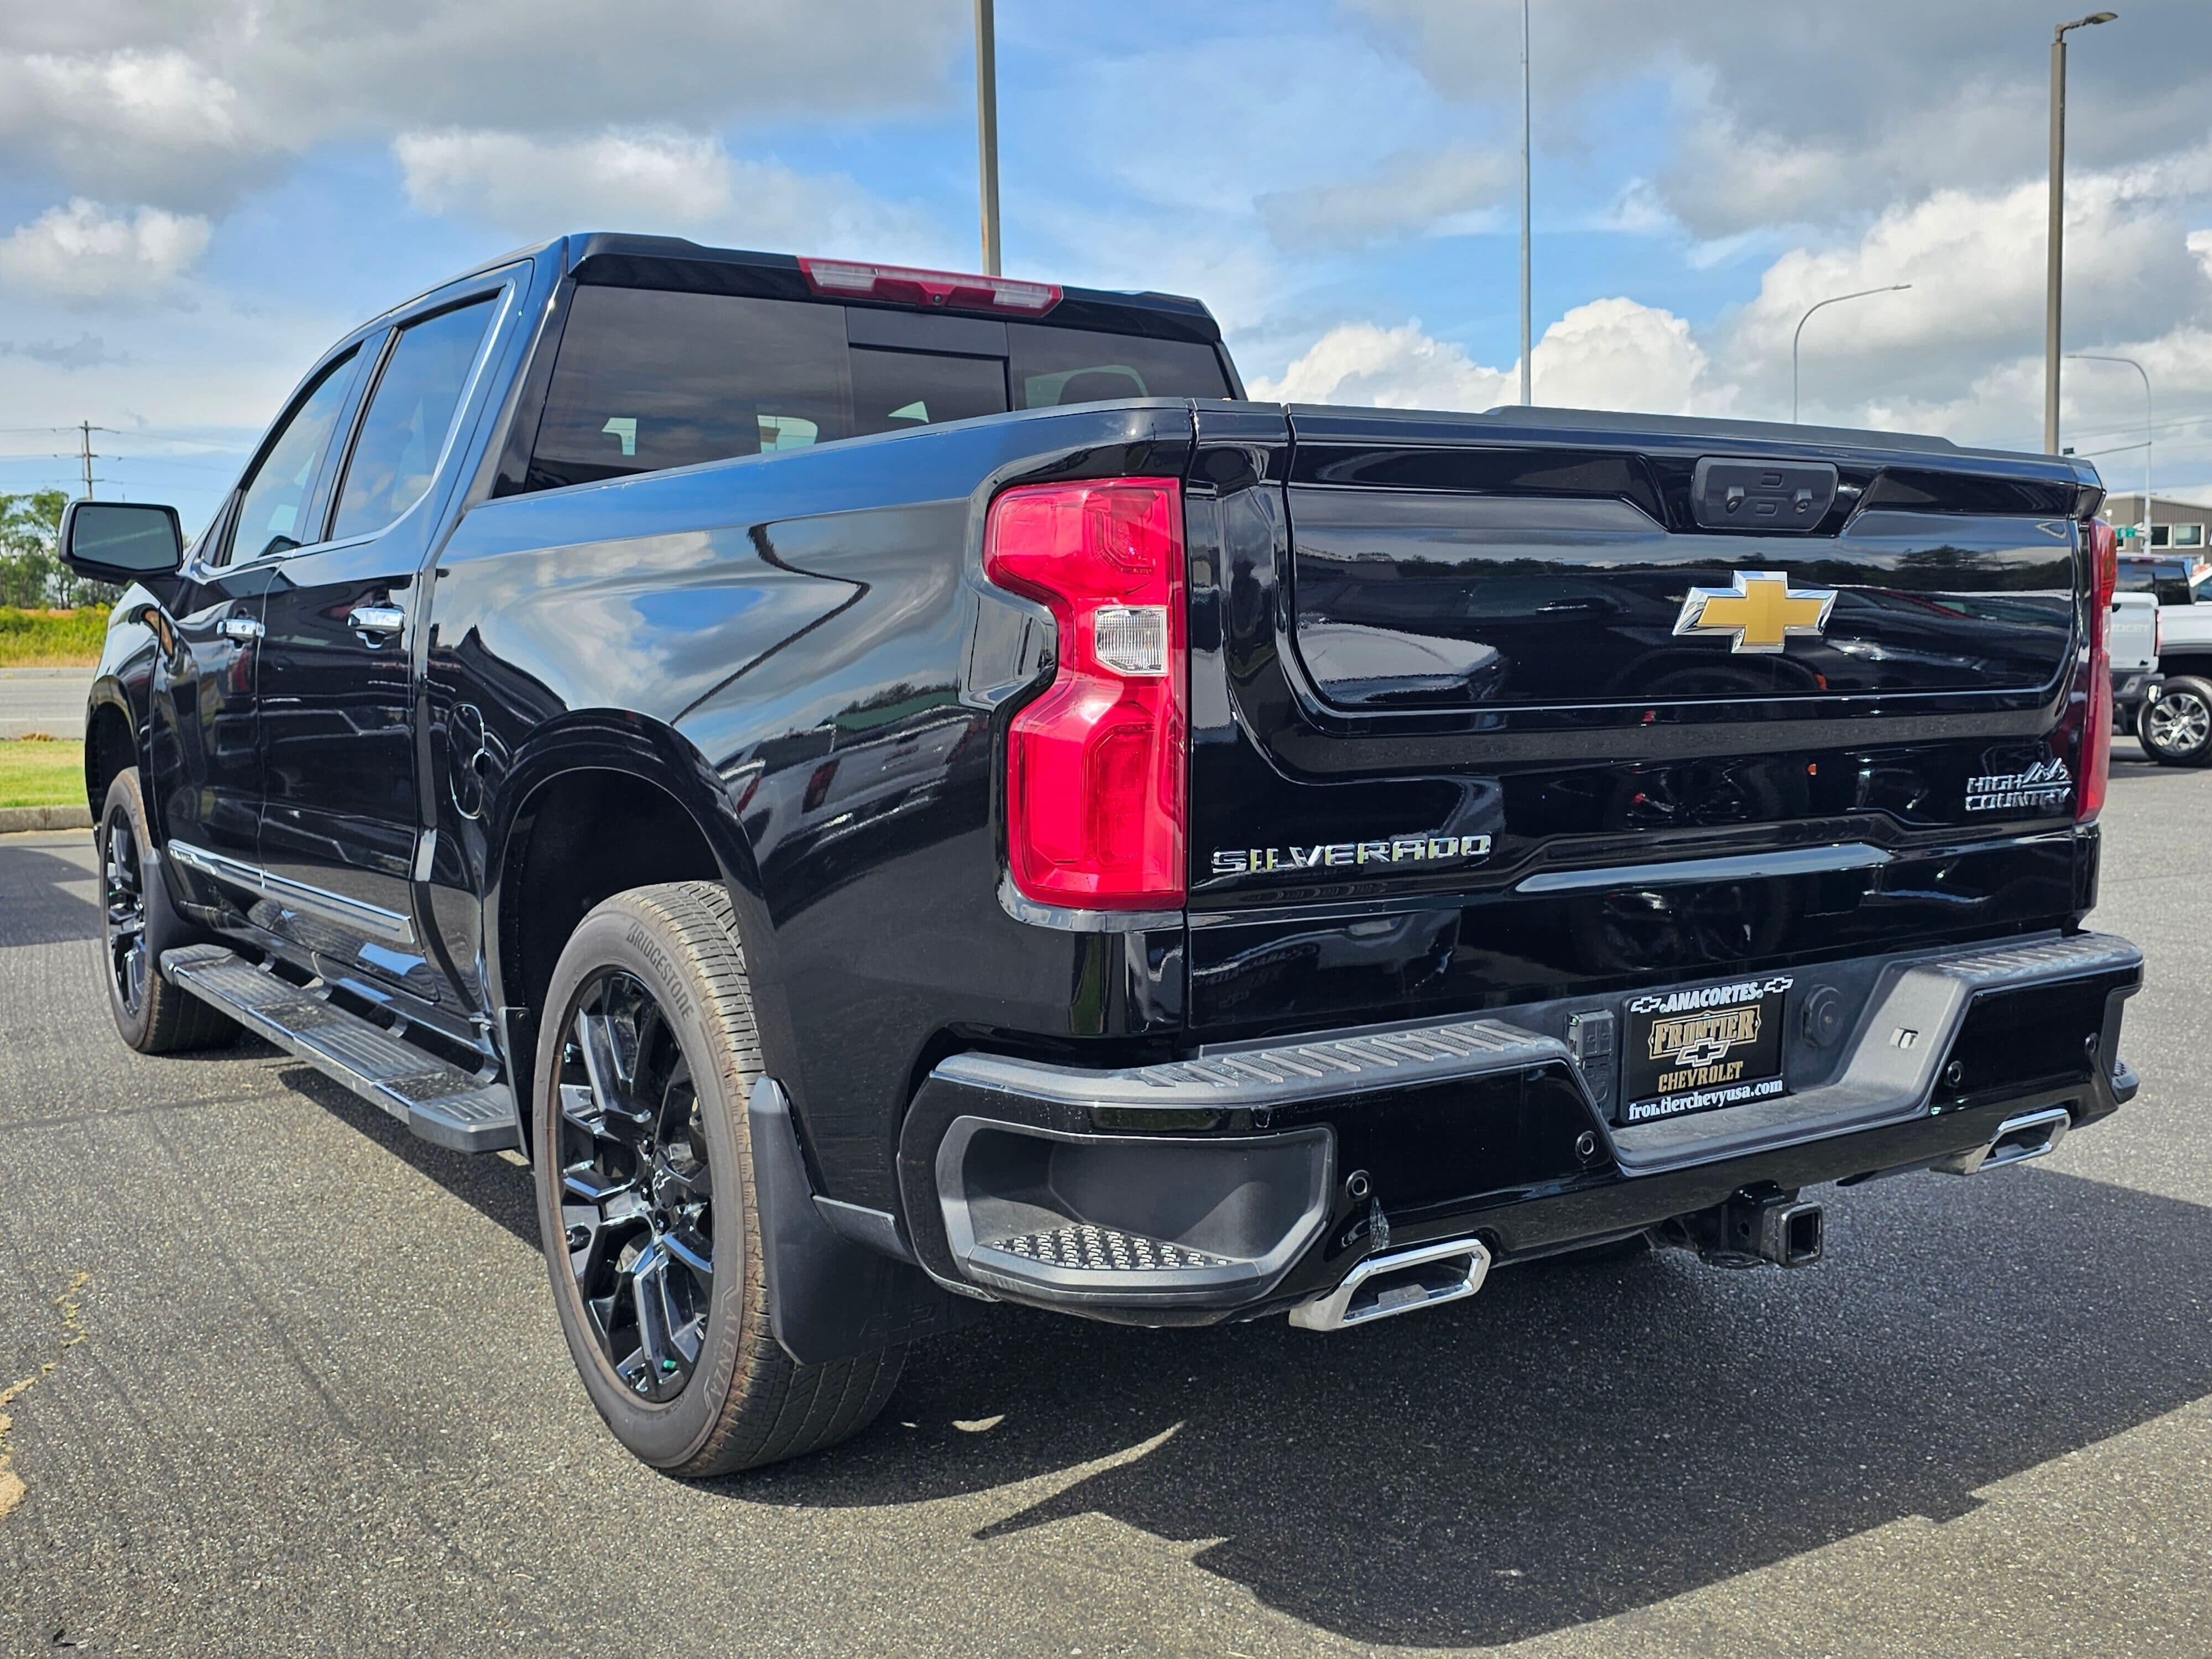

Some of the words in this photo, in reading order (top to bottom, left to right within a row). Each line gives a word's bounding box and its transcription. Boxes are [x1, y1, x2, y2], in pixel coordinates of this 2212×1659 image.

[1965, 787, 2070, 811] COUNTRY
[1967, 774, 2023, 793] HIGH
[1212, 835, 1491, 873] SILVERADO
[626, 922, 695, 1021] BRIDGESTONE
[1666, 982, 1759, 1013] ANACORTES
[1653, 1010, 1755, 1054] FRONTIER
[1658, 1061, 1744, 1092] CHEVROLET
[710, 1307, 738, 1396] ALENZA
